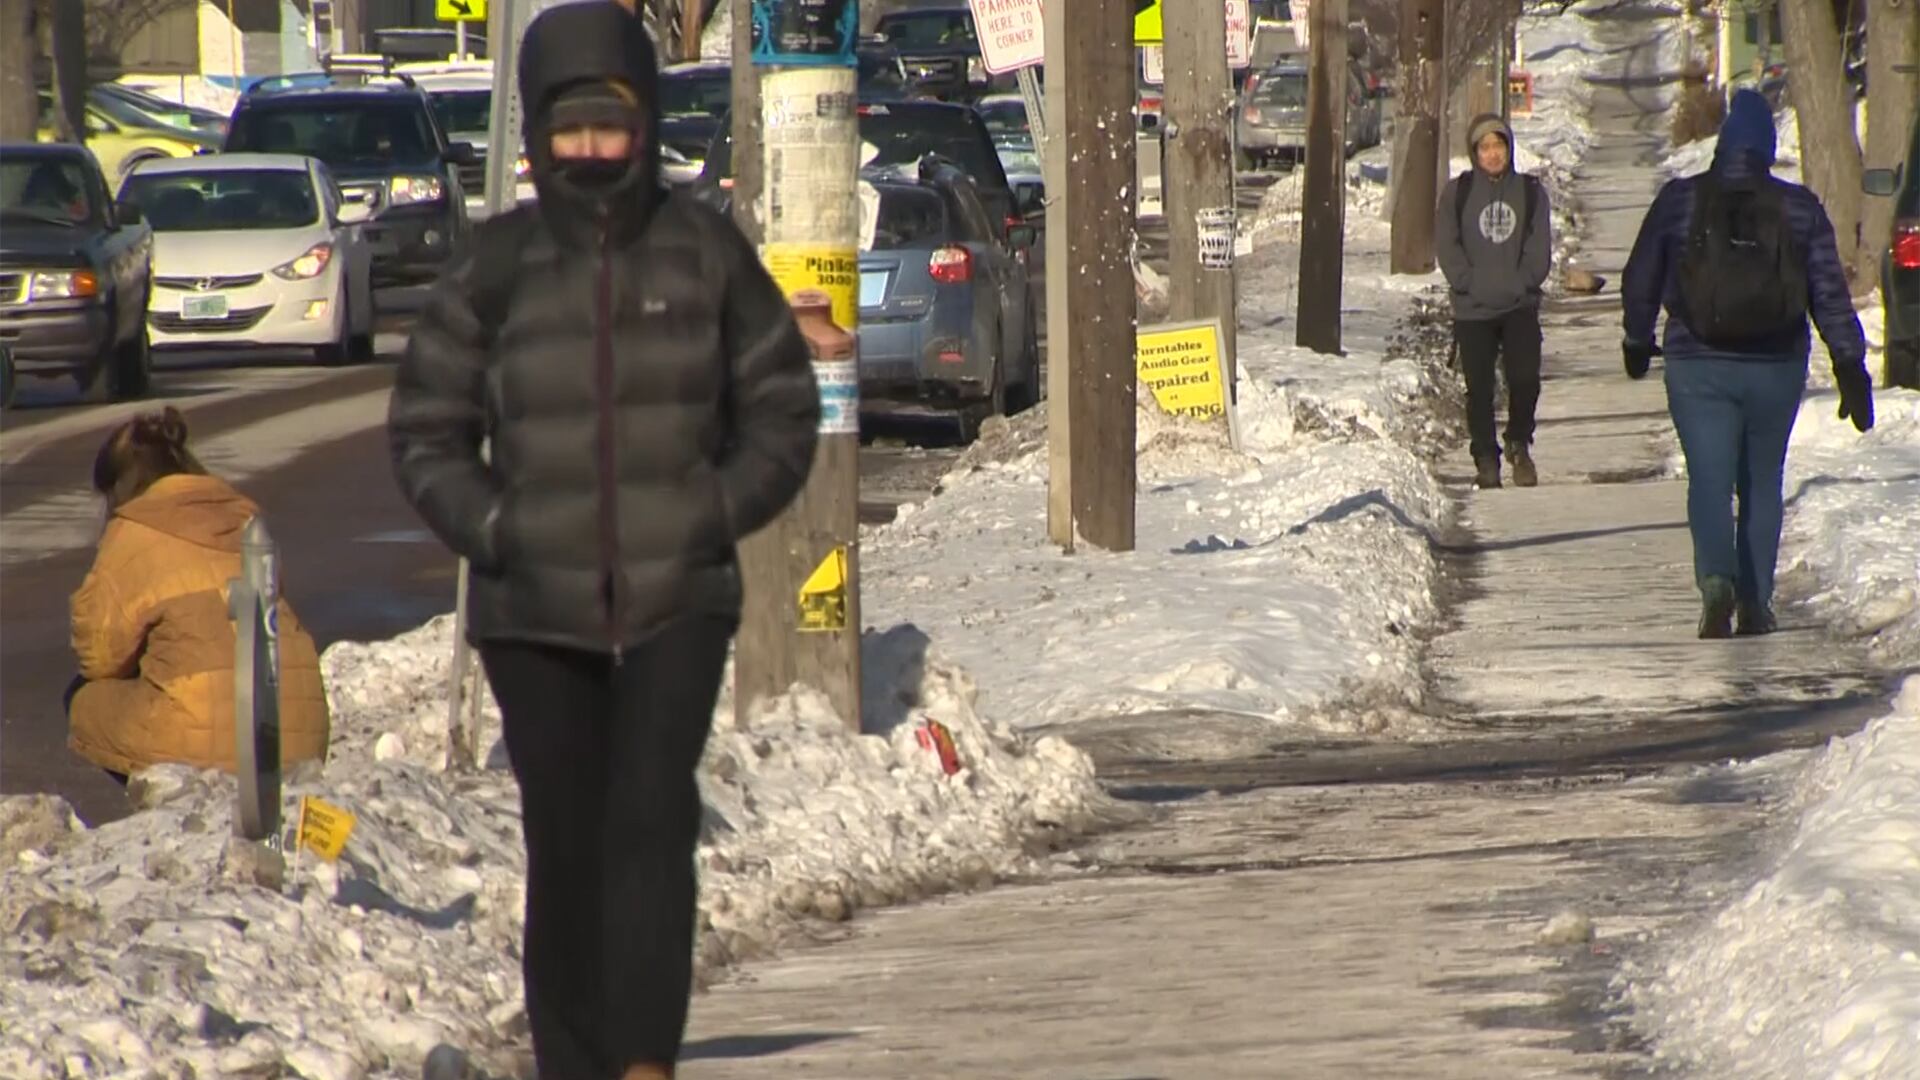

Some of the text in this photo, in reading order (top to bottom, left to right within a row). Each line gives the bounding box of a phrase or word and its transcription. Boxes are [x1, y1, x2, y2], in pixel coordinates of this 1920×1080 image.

[988, 10, 1033, 33] HERE TO
[996, 29, 1034, 49] CORNER
[1137, 342, 1202, 356] urntables
[1140, 355, 1210, 371] Audio Gear
[1146, 371, 1209, 390] epaired
